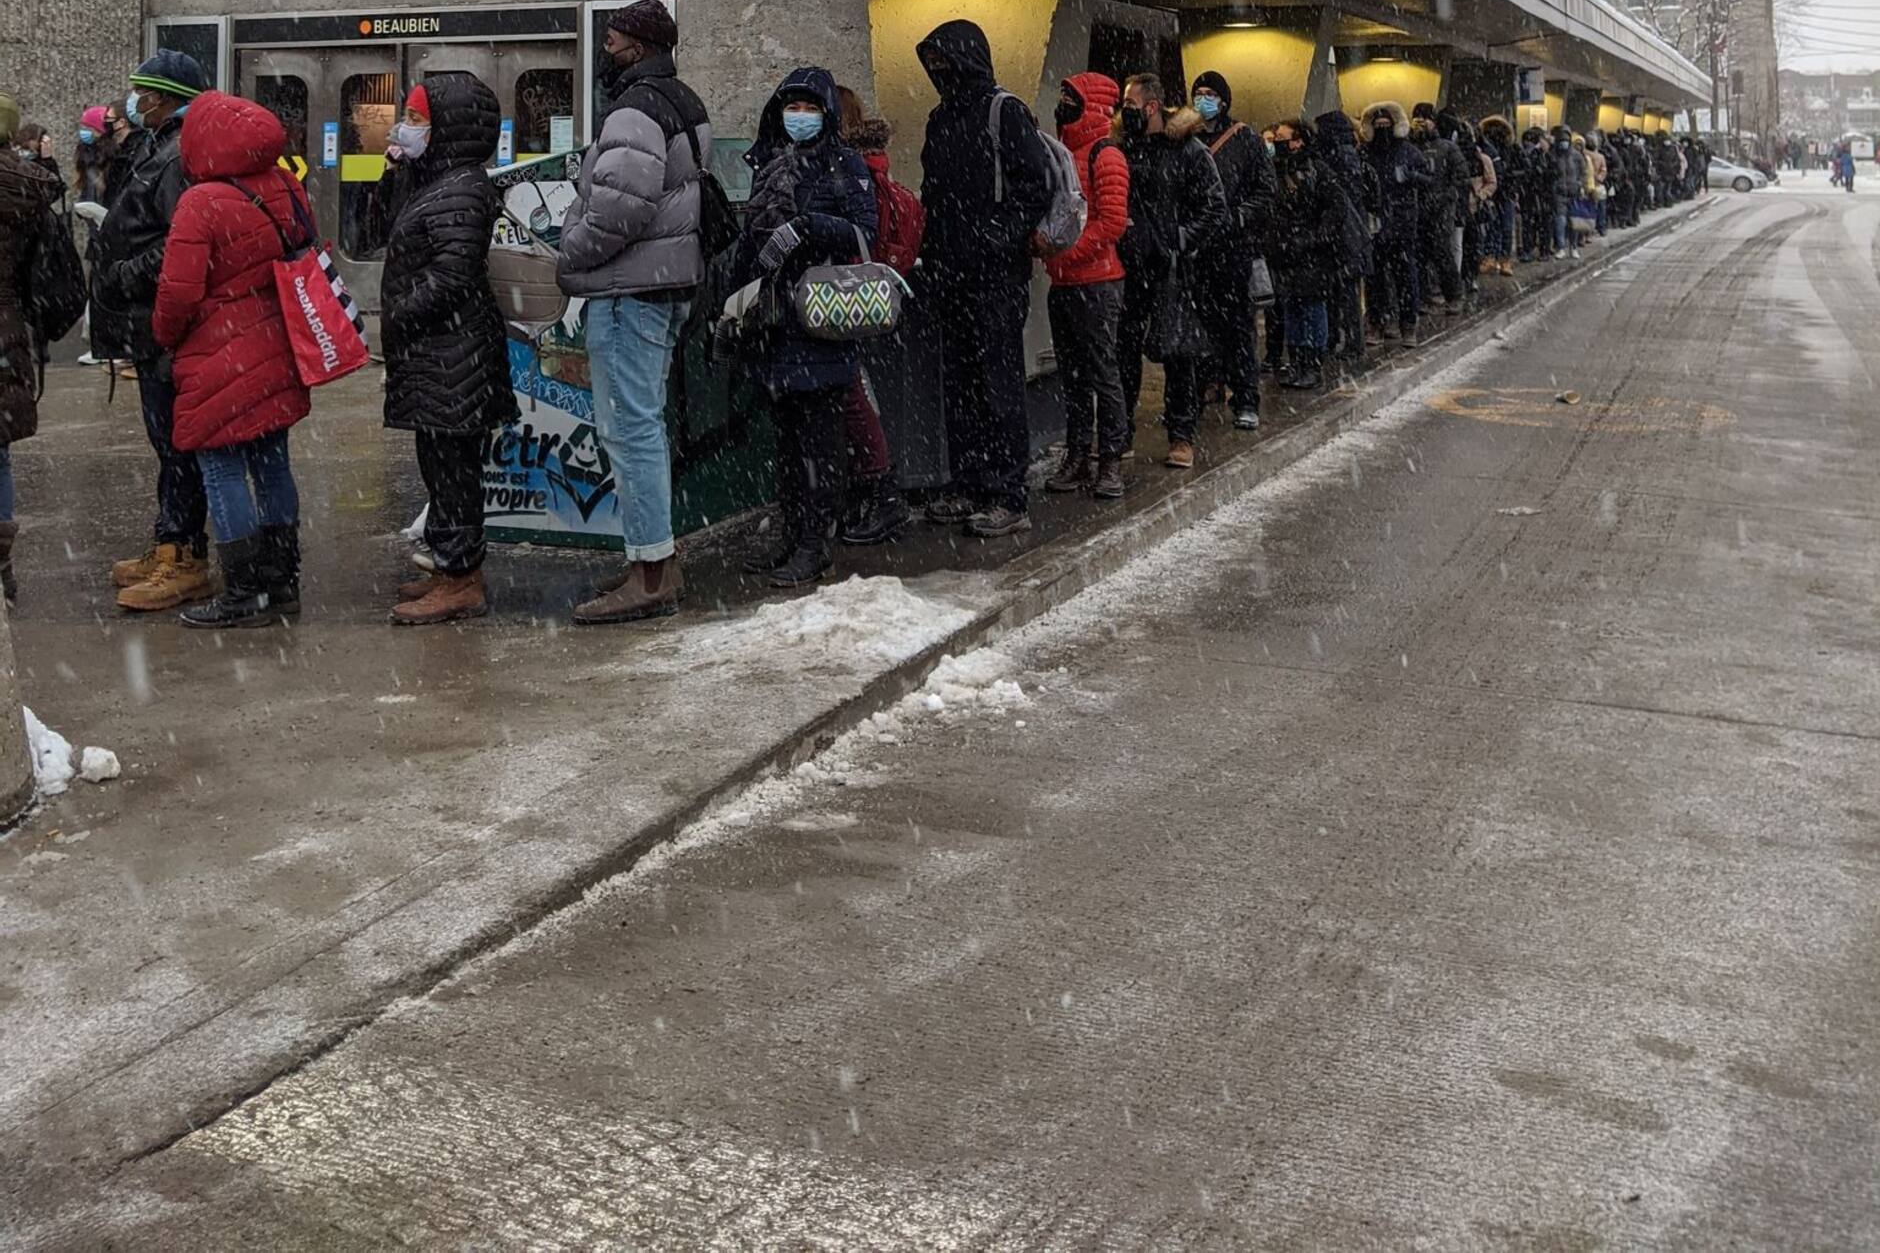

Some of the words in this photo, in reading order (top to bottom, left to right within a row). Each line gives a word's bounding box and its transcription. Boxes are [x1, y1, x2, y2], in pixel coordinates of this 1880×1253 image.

[373, 18, 440, 34] BEAUBIEN
[294, 275, 340, 373] Tupperware
[481, 471, 507, 484] ous
[511, 471, 529, 485] est
[482, 487, 547, 510] ropre
